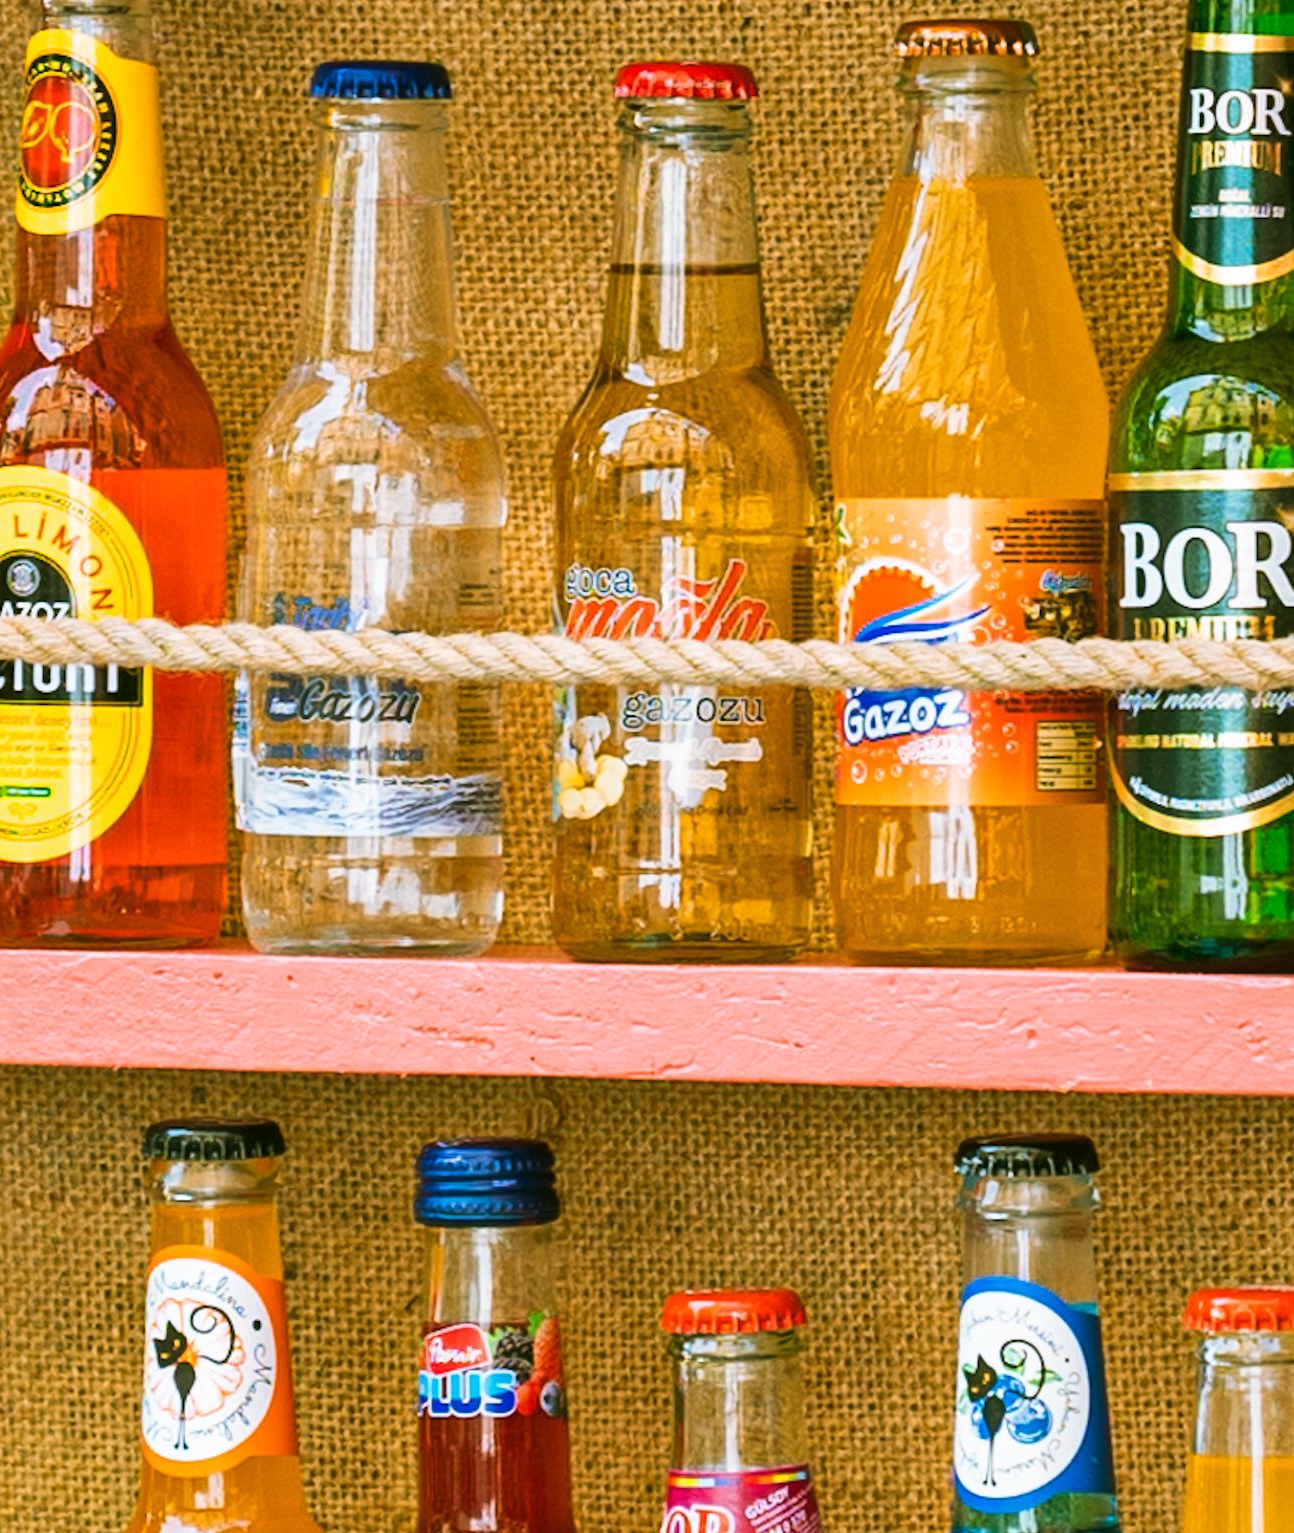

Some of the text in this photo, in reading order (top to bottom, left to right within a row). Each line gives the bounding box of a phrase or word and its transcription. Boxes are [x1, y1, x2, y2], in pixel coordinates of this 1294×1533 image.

[1187, 88, 1293, 136] BOR
[1192, 140, 1282, 177] PREMIUM
[13, 511, 114, 610] LİMON
[1119, 520, 1294, 610] BOR
[299, 677, 420, 724] Gazozu
[622, 693, 766, 730] gazozu
[844, 690, 970, 745] Gazoz
[430, 1337, 482, 1364] Pamir
